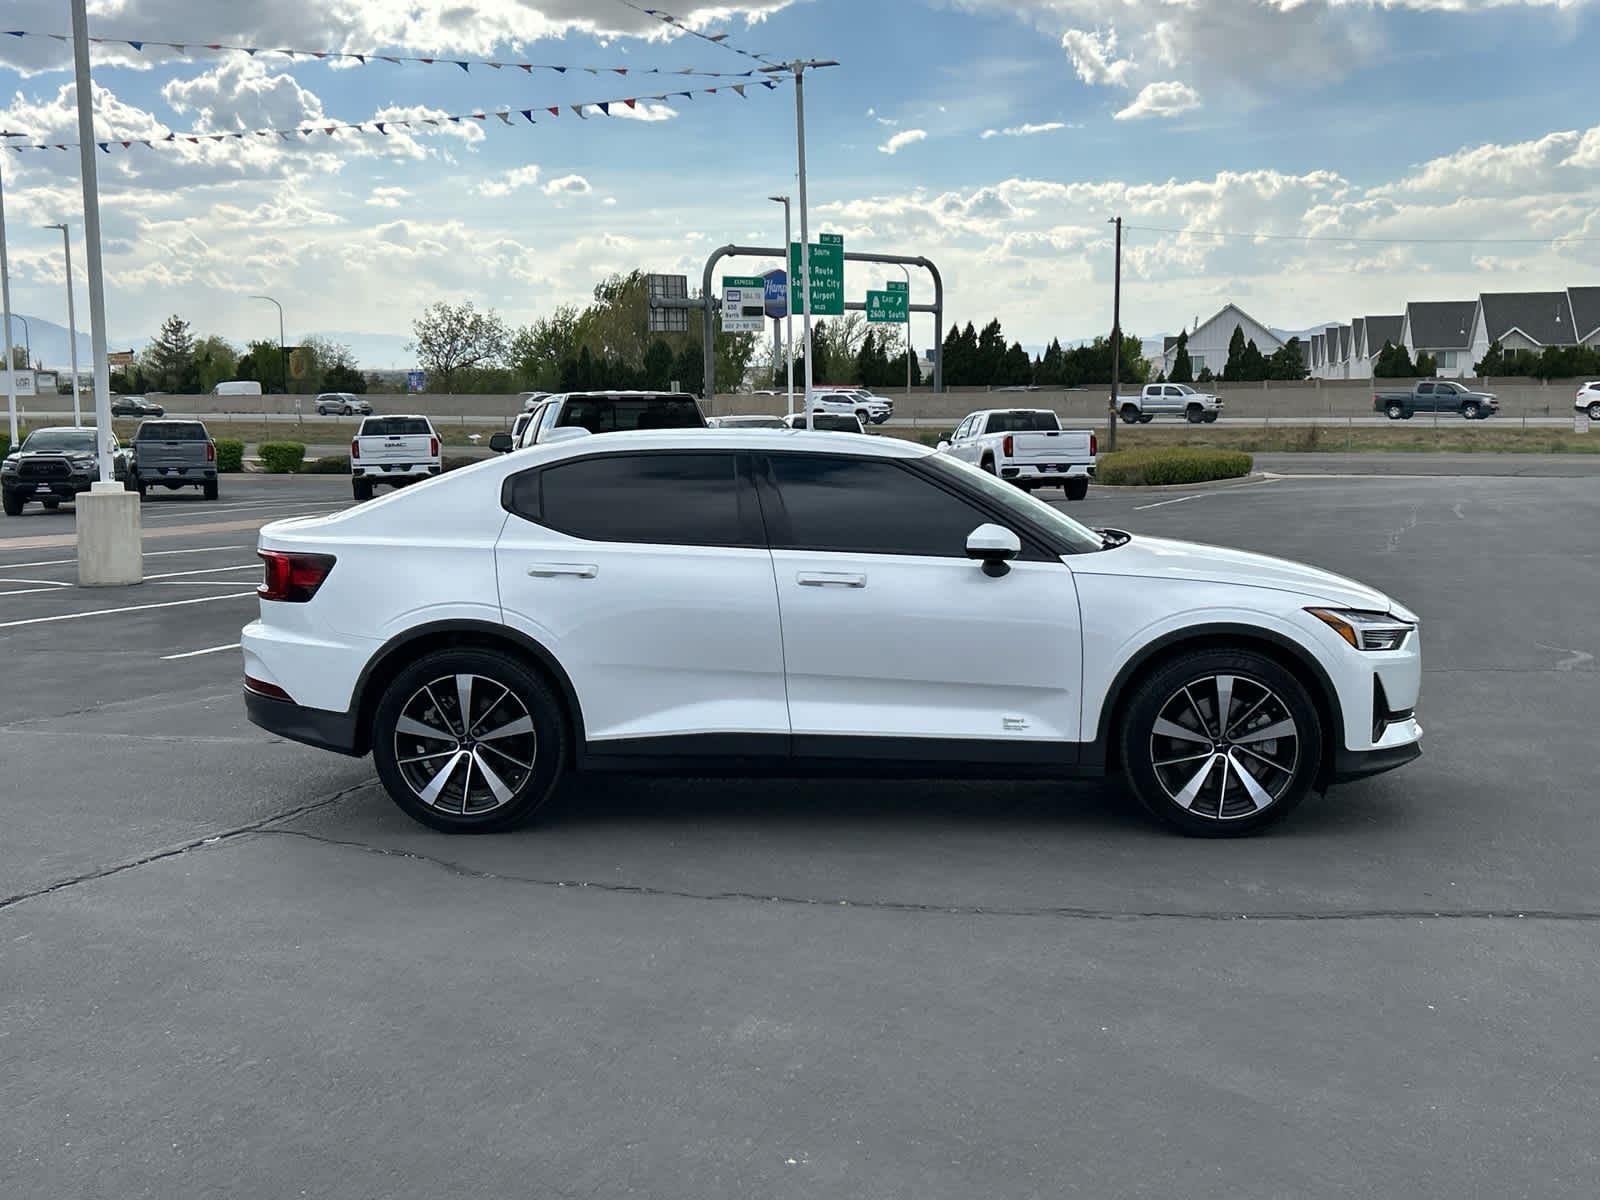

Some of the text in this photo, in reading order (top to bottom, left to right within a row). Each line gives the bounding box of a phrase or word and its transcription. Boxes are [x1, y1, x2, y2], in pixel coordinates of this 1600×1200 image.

[815, 266, 833, 275] Route
[764, 279, 787, 298] Hamp
[827, 279, 841, 289] City
[813, 291, 836, 301] Airport
[888, 310, 905, 319] South
